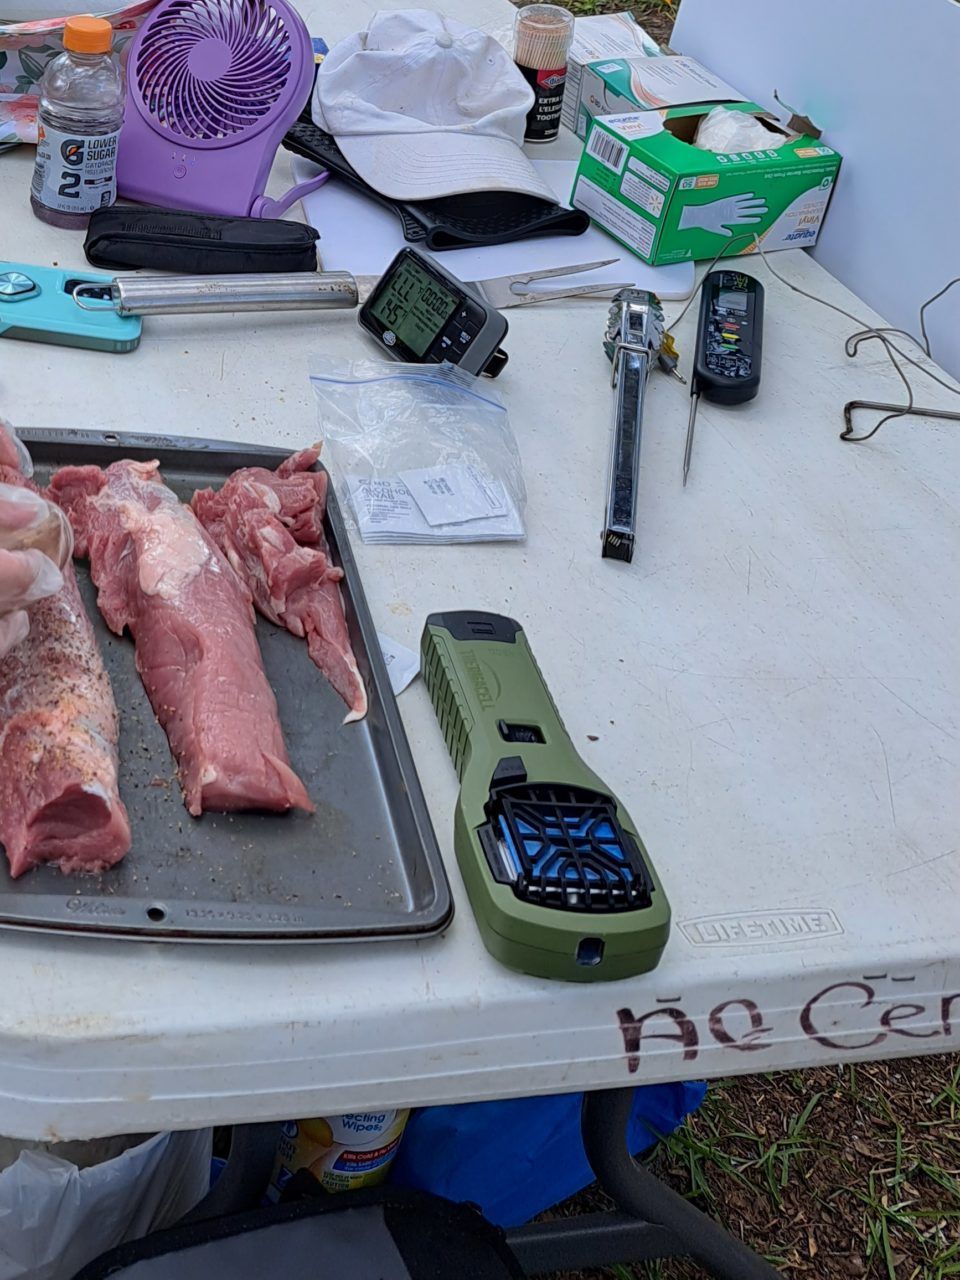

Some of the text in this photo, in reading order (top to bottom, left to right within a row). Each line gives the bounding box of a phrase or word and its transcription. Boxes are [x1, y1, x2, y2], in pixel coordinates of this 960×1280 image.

[61, 139, 85, 166] G
[88, 135, 117, 150] LOWER
[86, 147, 116, 161] SUGAR
[58, 171, 81, 199] 2
[799, 215, 820, 226] Vinyl
[784, 230, 816, 241] equate
[696, 915, 829, 943] LIFETIME
[342, 1111, 386, 1124] ecting
[342, 1120, 379, 1133] Wipes
